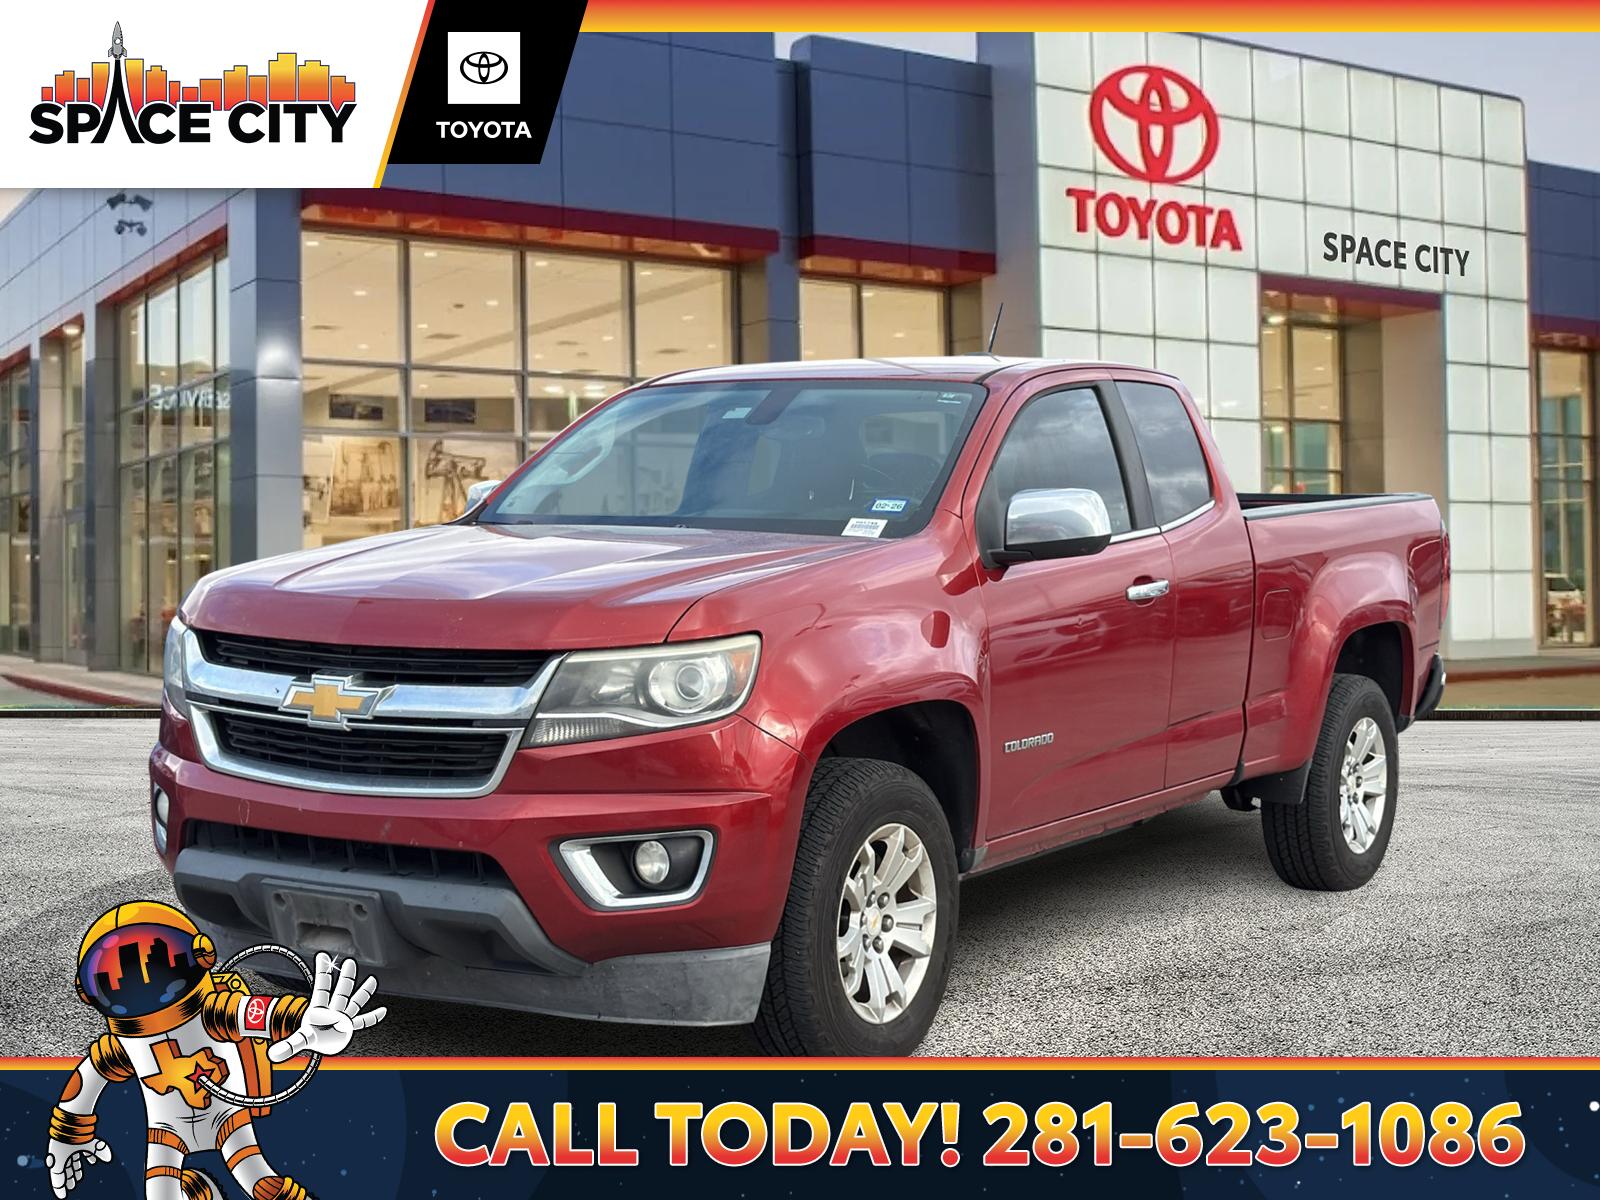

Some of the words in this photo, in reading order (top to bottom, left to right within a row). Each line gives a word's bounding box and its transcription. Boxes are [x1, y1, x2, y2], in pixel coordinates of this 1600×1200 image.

[1065, 187, 1243, 252] TOYOTA
[1322, 231, 1408, 270] SPACE
[1414, 243, 1470, 277] CITY
[1004, 732, 1055, 753] COLORADO
